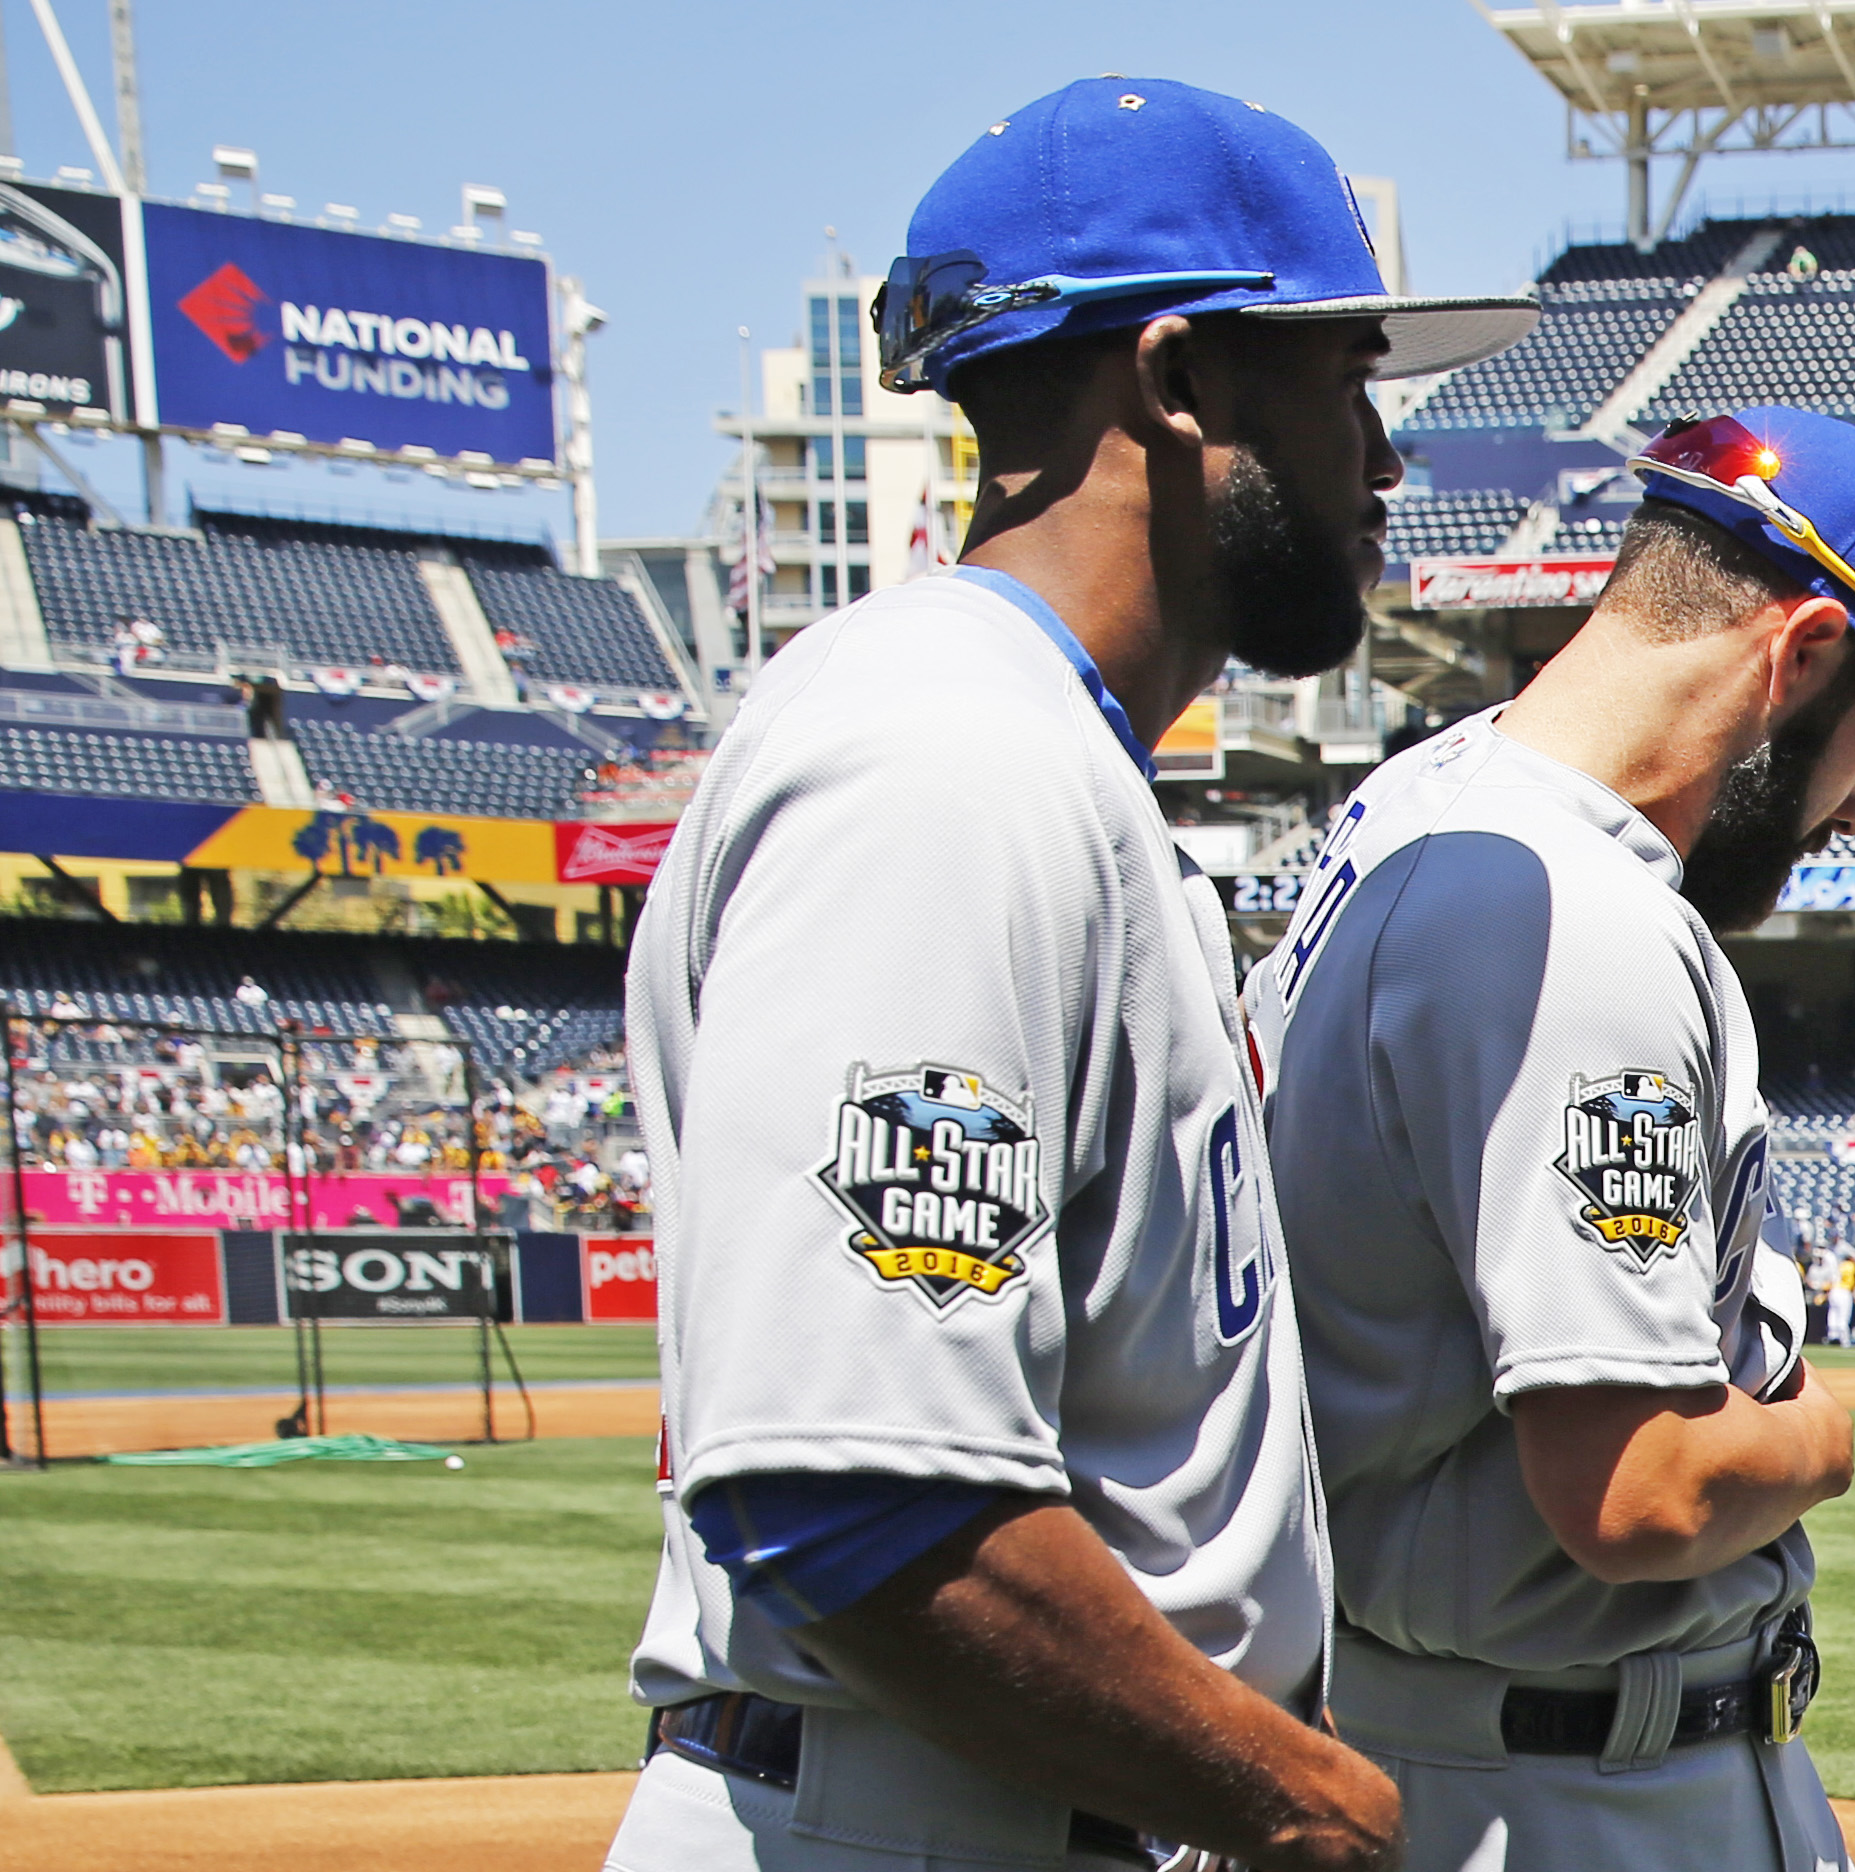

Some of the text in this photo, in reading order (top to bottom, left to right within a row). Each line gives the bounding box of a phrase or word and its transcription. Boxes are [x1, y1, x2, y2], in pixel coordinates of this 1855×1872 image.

[281, 301, 530, 371] NATIONAL
[285, 346, 510, 410] FUNDING
[1420, 566, 1571, 603] Tarantino
[1234, 876, 1309, 911] 2:2
[837, 1103, 1039, 1221] ALL STAR
[1566, 1107, 1626, 1174] ALL
[1603, 1169, 1676, 1210] GAME
[882, 1186, 1001, 1249] GAME
[1613, 1217, 1669, 1240] 2016
[32, 1246, 155, 1290] hero
[590, 1246, 657, 1290] pet
[895, 1252, 988, 1283] 2016
